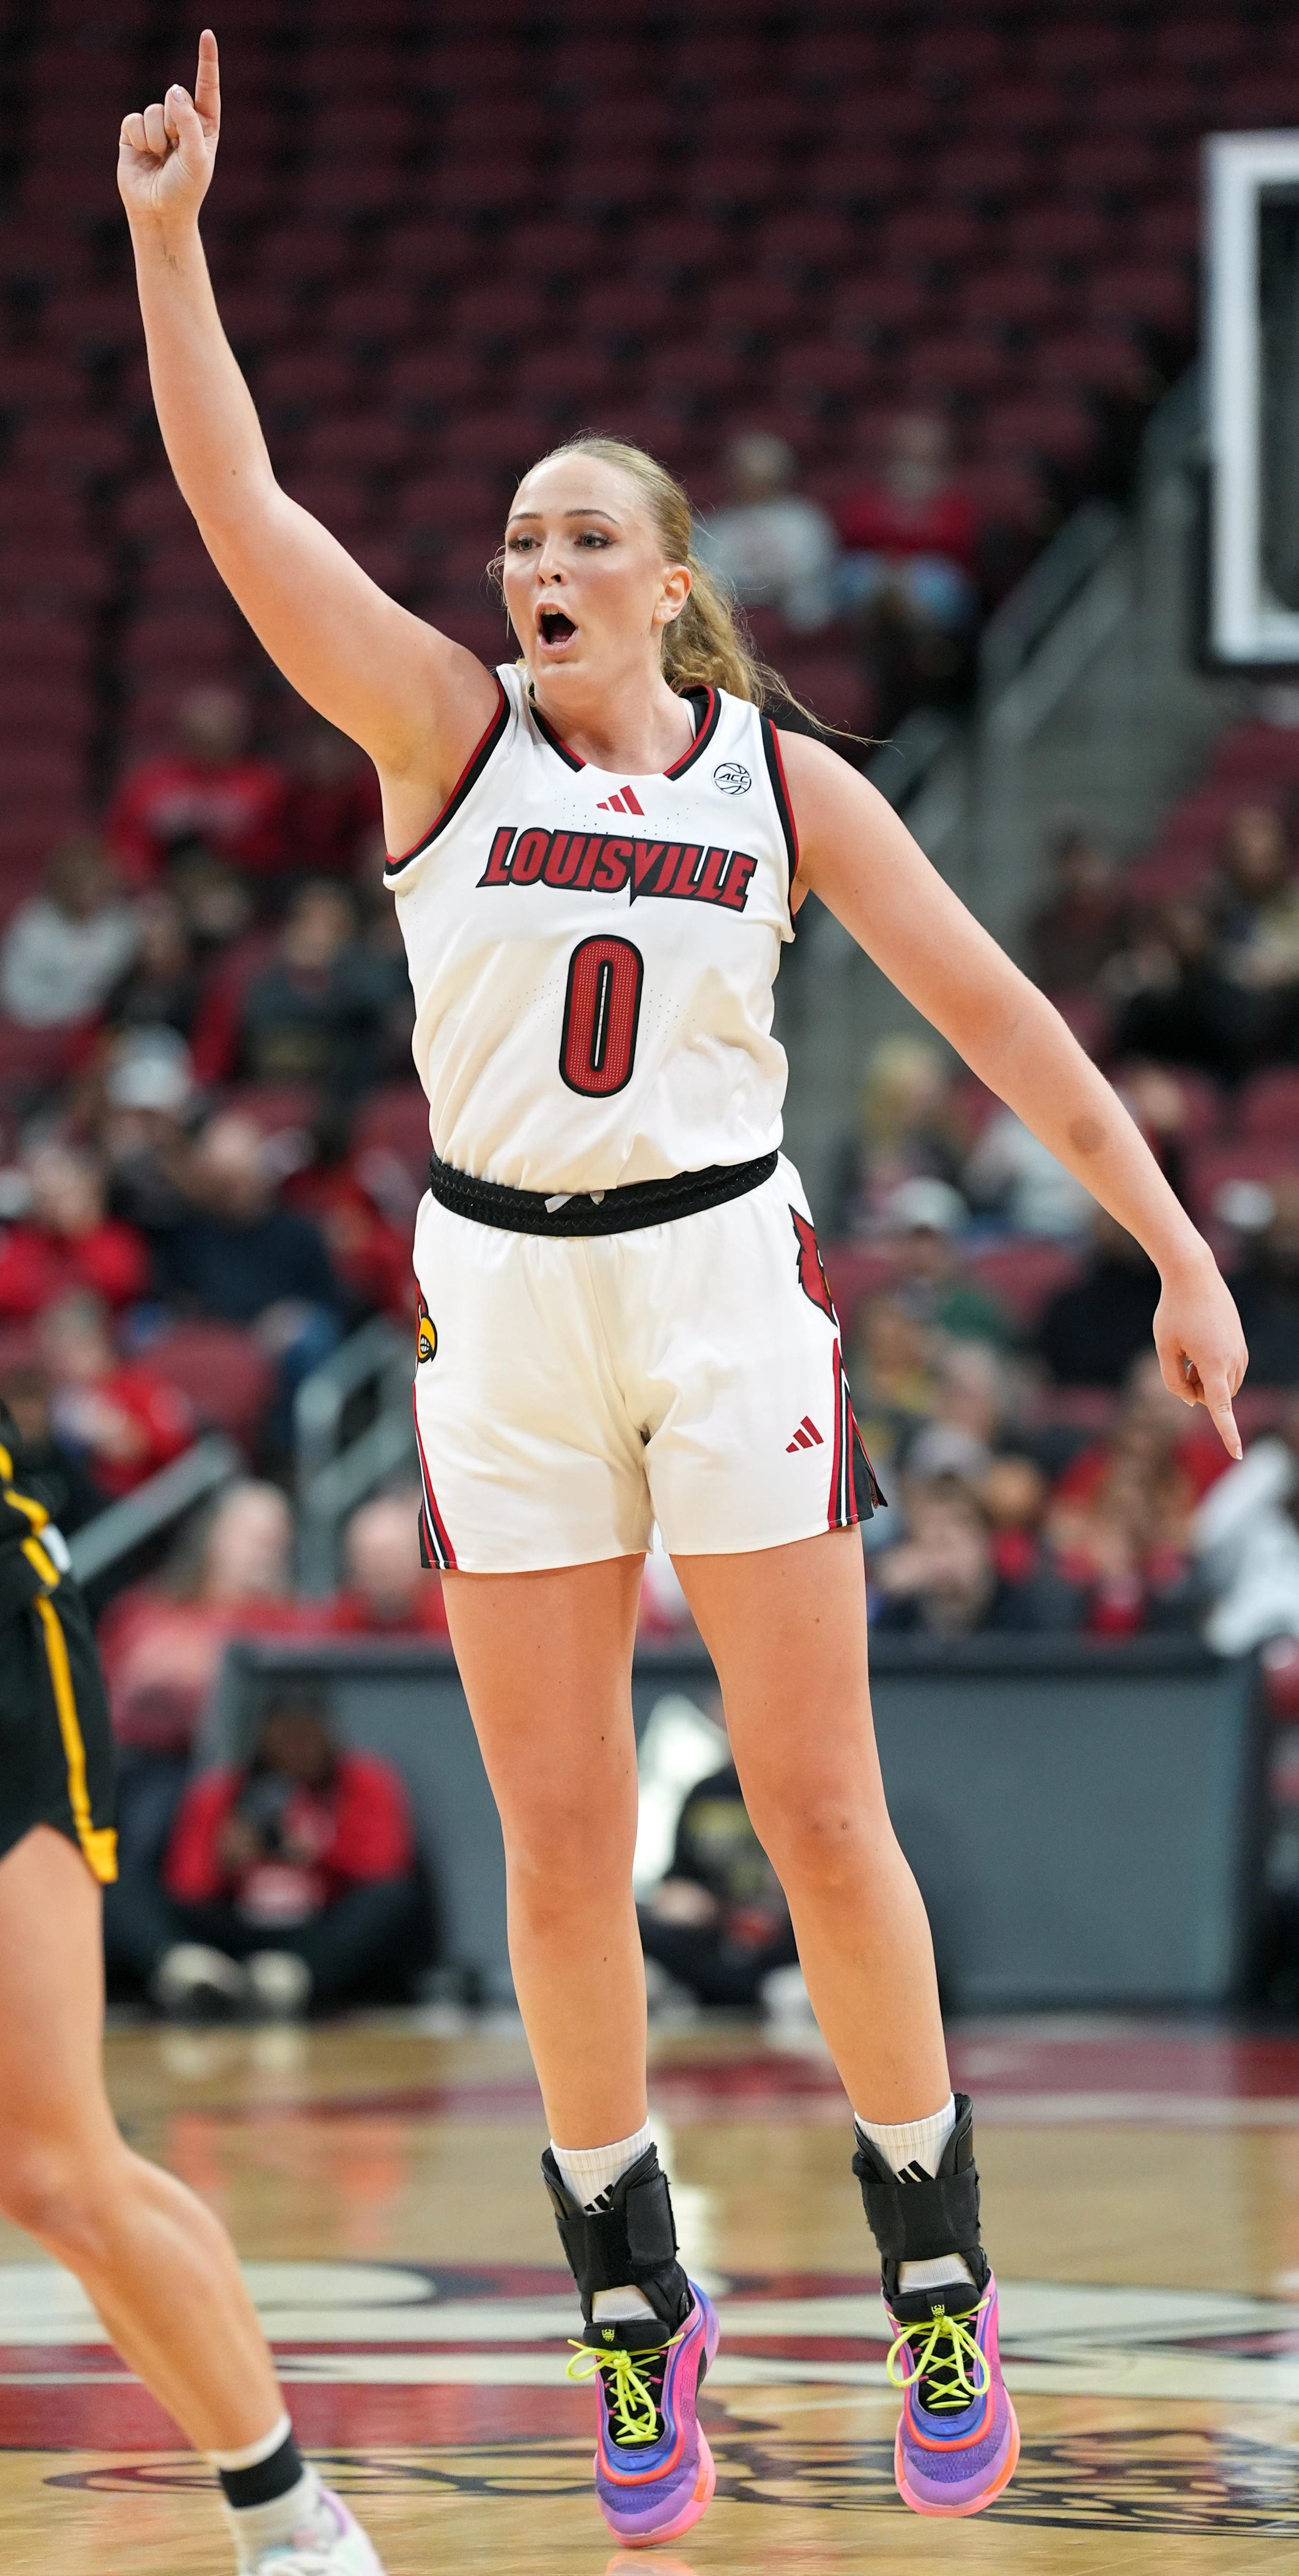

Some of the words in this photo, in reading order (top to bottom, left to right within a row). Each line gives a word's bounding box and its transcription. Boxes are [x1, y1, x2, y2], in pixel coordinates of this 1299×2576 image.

[717, 773, 751, 784] ACC
[476, 827, 757, 912] LOUISVILLE
[559, 934, 644, 1098] 0
